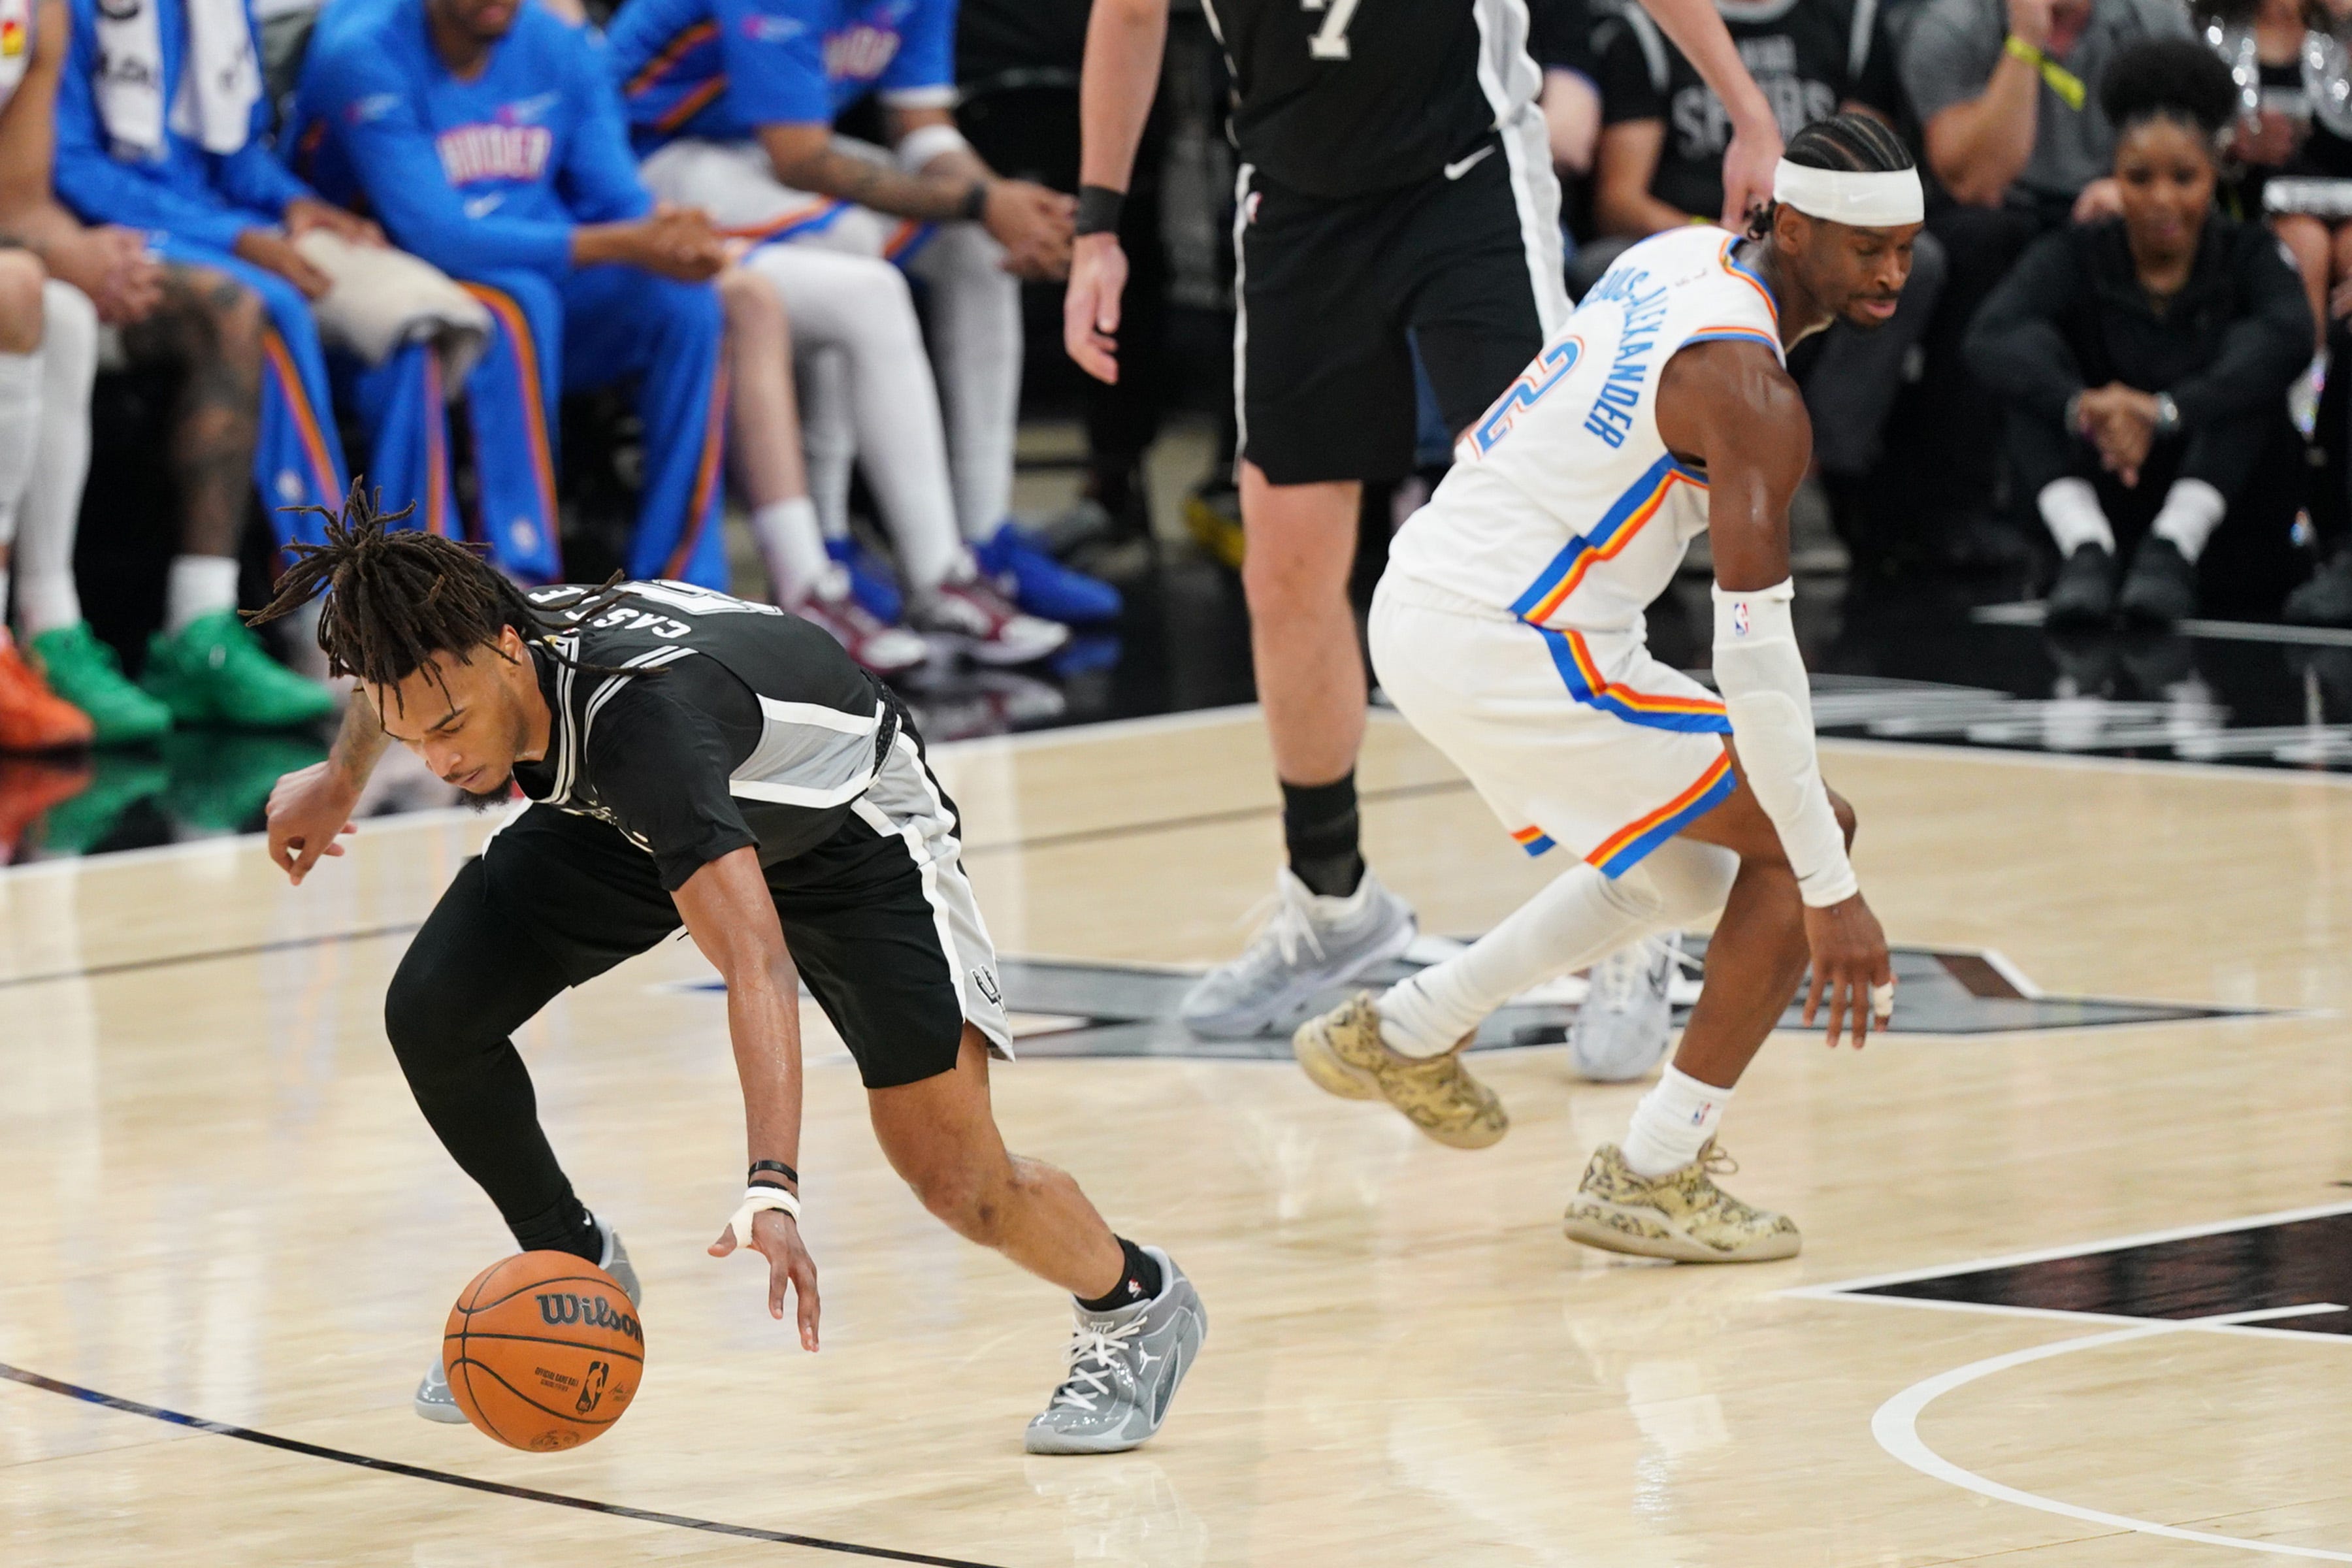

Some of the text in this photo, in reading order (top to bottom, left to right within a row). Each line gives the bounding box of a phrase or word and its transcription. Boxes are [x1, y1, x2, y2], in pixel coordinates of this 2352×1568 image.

[1298, 0, 1362, 61] 7
[1671, 73, 1835, 161] SPRS
[1468, 335, 1584, 459] 2
[535, 1293, 644, 1347] Wilson
